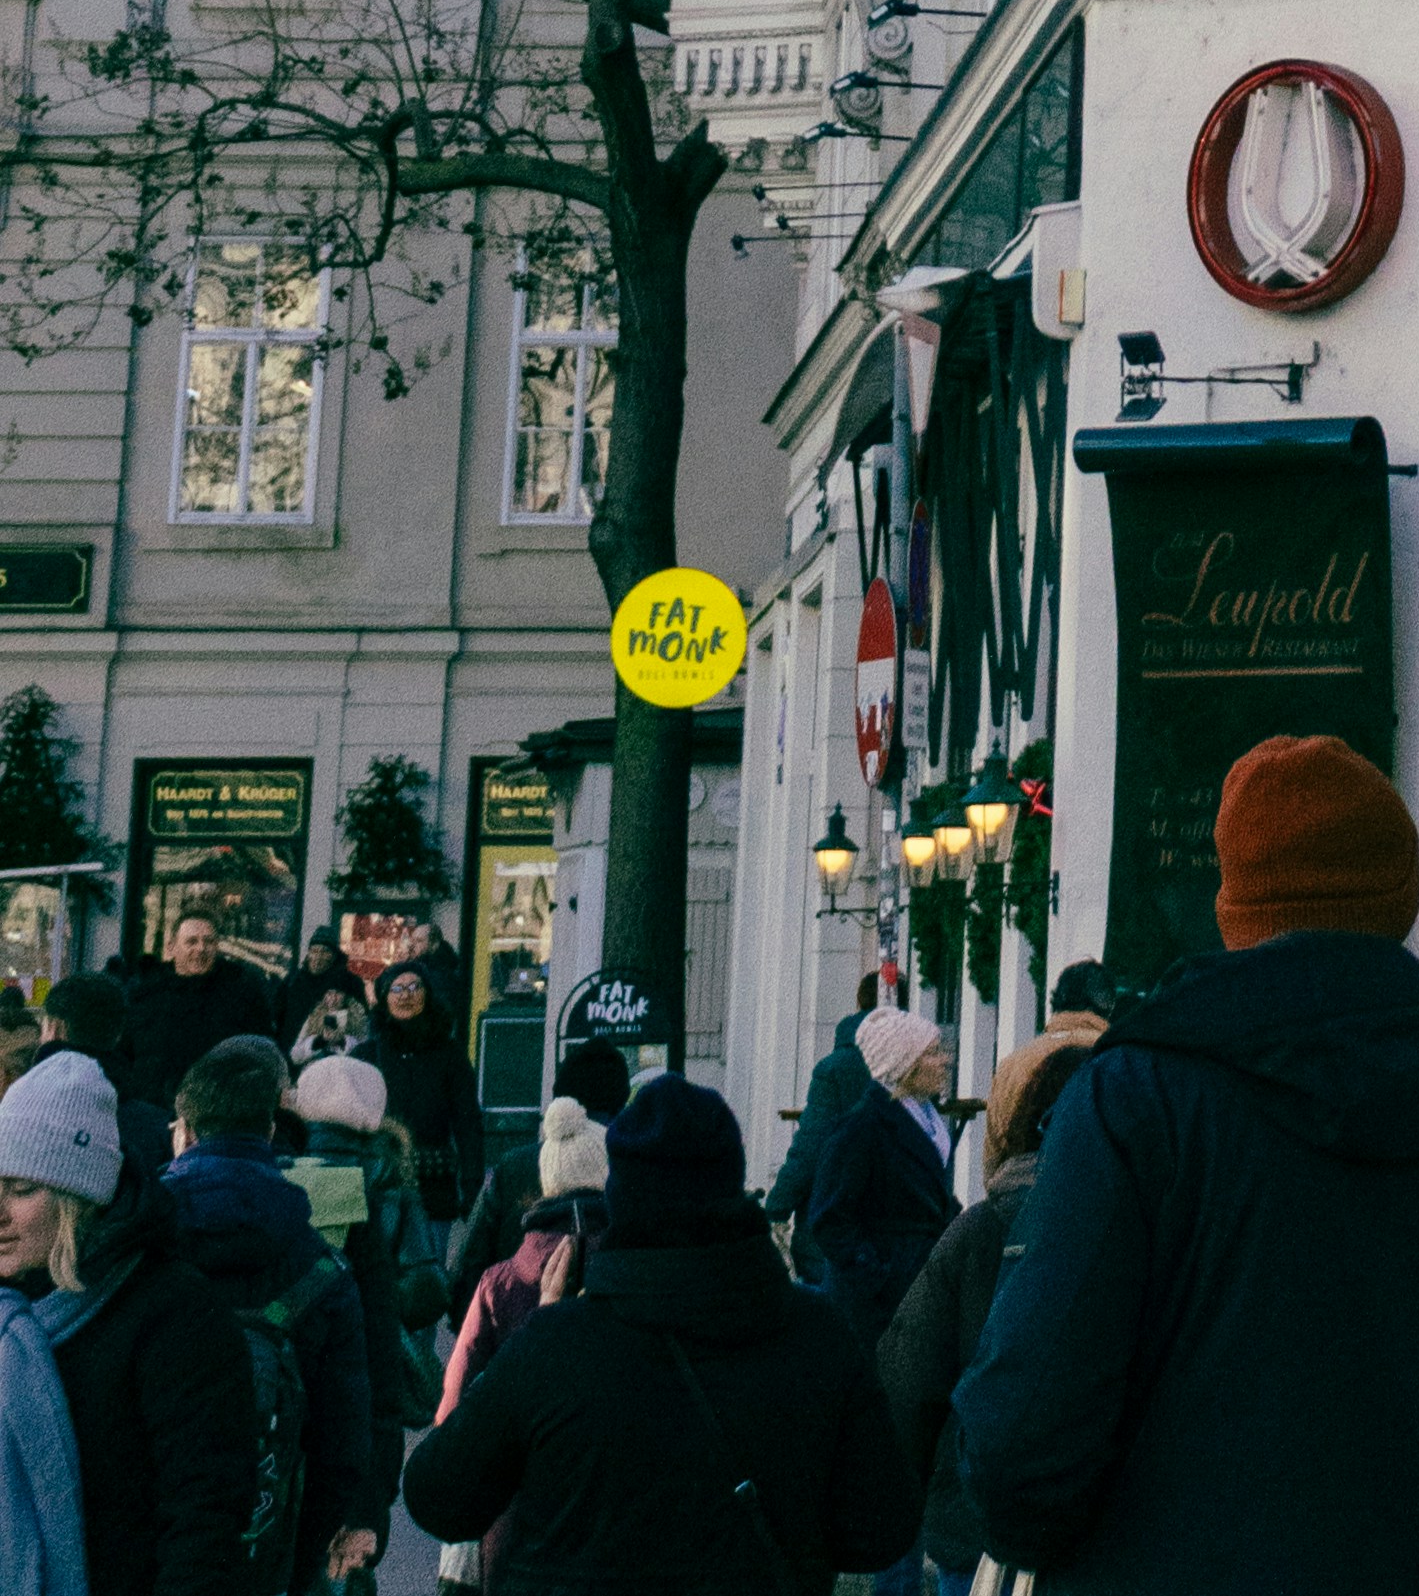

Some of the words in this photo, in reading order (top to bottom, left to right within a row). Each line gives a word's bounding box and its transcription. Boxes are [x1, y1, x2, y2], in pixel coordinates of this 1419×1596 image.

[1142, 531, 1369, 658] Leupold
[648, 597, 705, 634] FAT
[218, 785, 232, 802] &
[599, 980, 636, 1004] FAT
